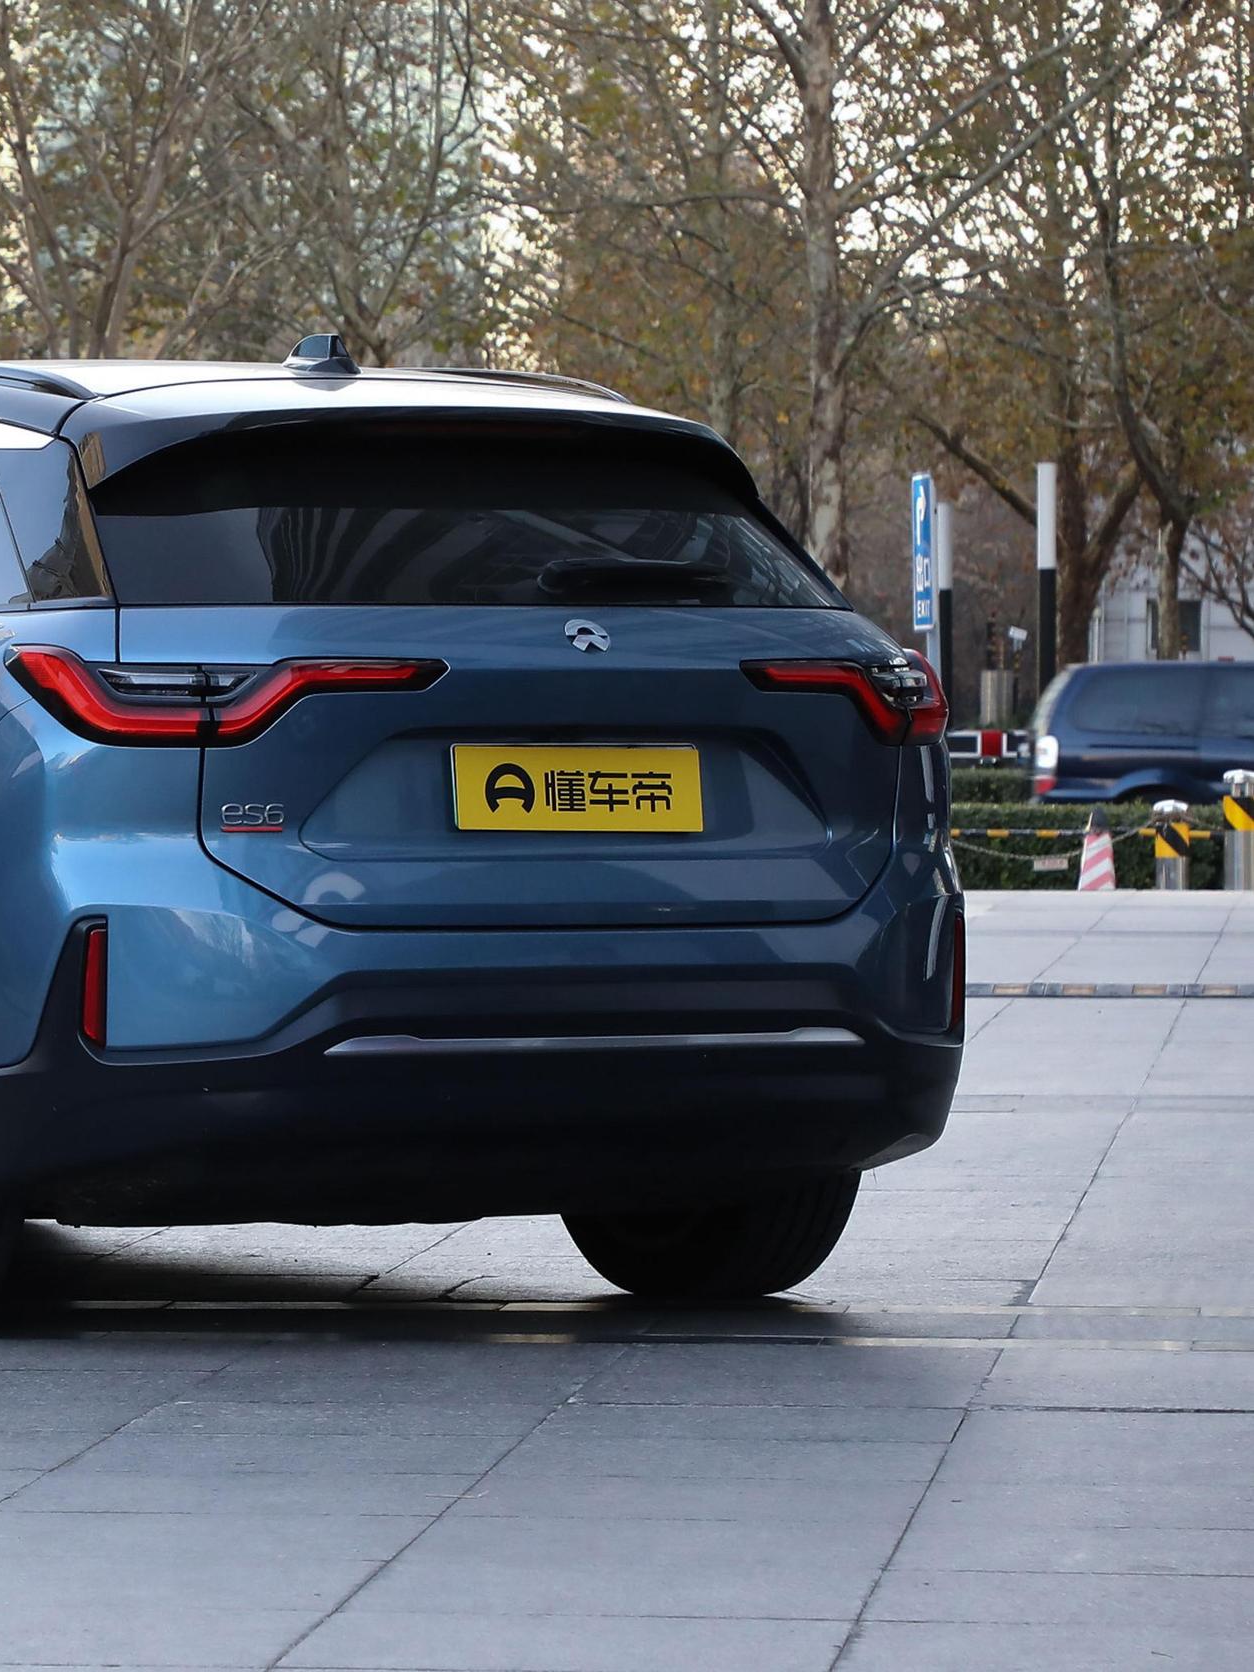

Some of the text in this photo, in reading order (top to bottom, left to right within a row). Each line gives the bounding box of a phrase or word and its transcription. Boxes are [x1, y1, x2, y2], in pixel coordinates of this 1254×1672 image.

[917, 599, 930, 618] EXIT
[544, 770, 673, 813] 懂车帝
[221, 803, 284, 825] es6
